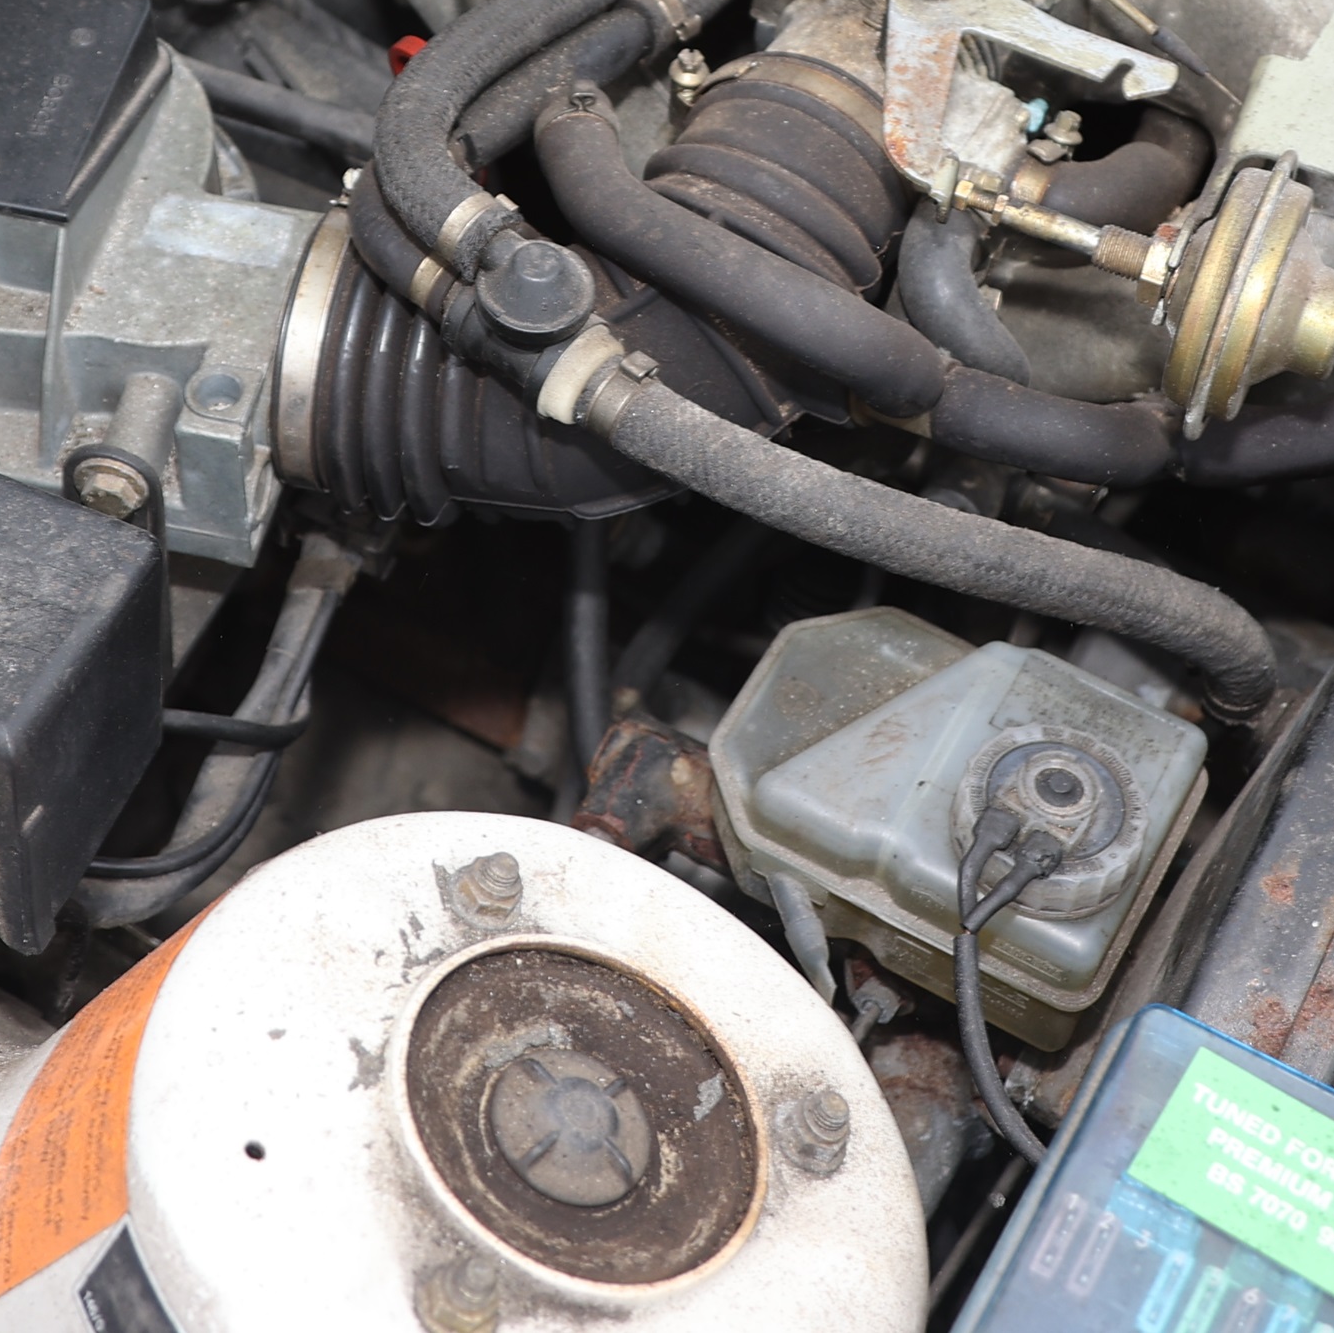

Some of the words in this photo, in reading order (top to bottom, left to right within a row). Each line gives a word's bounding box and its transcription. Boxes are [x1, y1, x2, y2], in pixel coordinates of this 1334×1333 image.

[27, 73, 72, 135] BOSCH
[1186, 1082, 1284, 1148] TUNED
[1204, 1161, 1247, 1196] BS
[1245, 1185, 1309, 1232] 7070
[1067, 1193, 1079, 1209] 1
[1098, 1212, 1115, 1229] 2
[1135, 1230, 1153, 1249] 3
[1243, 1287, 1261, 1305] 6
